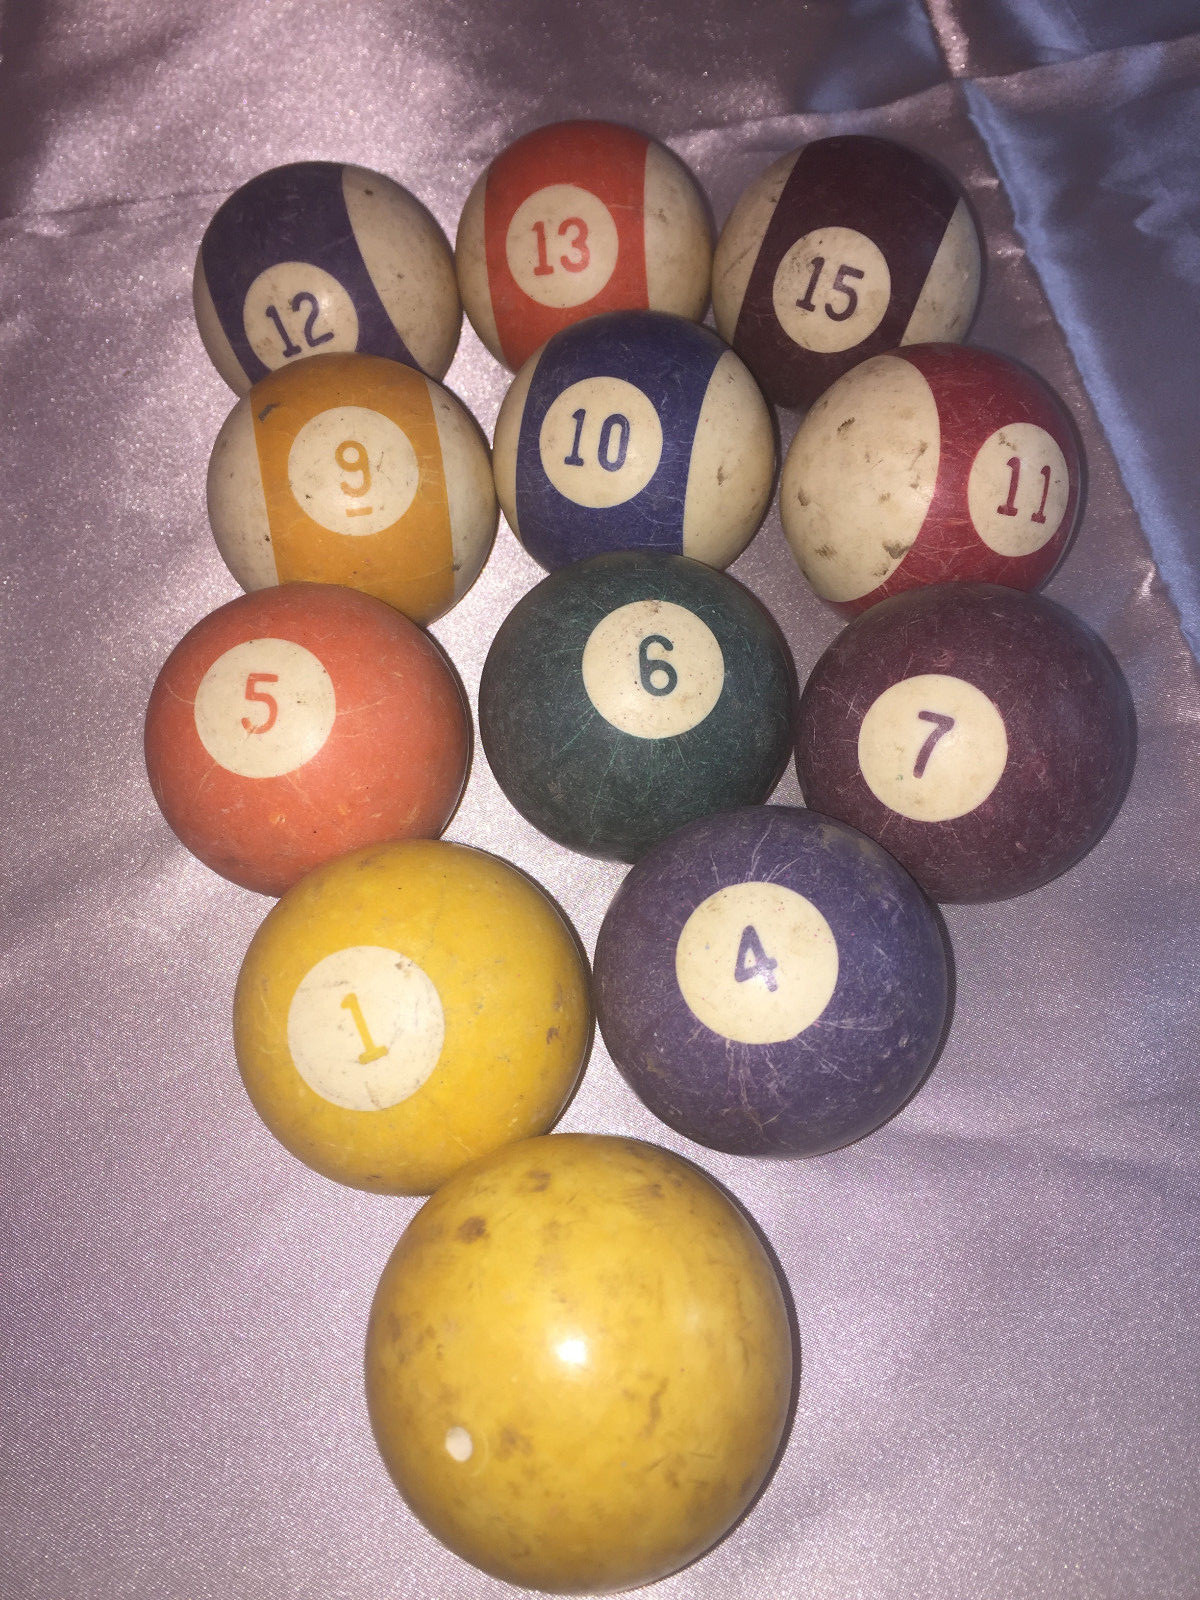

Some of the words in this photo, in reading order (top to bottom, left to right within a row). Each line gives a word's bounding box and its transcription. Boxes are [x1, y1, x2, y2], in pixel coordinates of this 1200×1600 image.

[532, 217, 591, 277] 13
[796, 256, 865, 322] 15
[266, 291, 335, 358] 12
[334, 440, 372, 498] 9
[564, 408, 631, 473] 10
[996, 456, 1051, 524] 11
[638, 634, 679, 697] 6
[241, 673, 279, 735] 5
[913, 711, 955, 778] 7
[734, 925, 778, 993] 4
[340, 993, 390, 1066] 1
